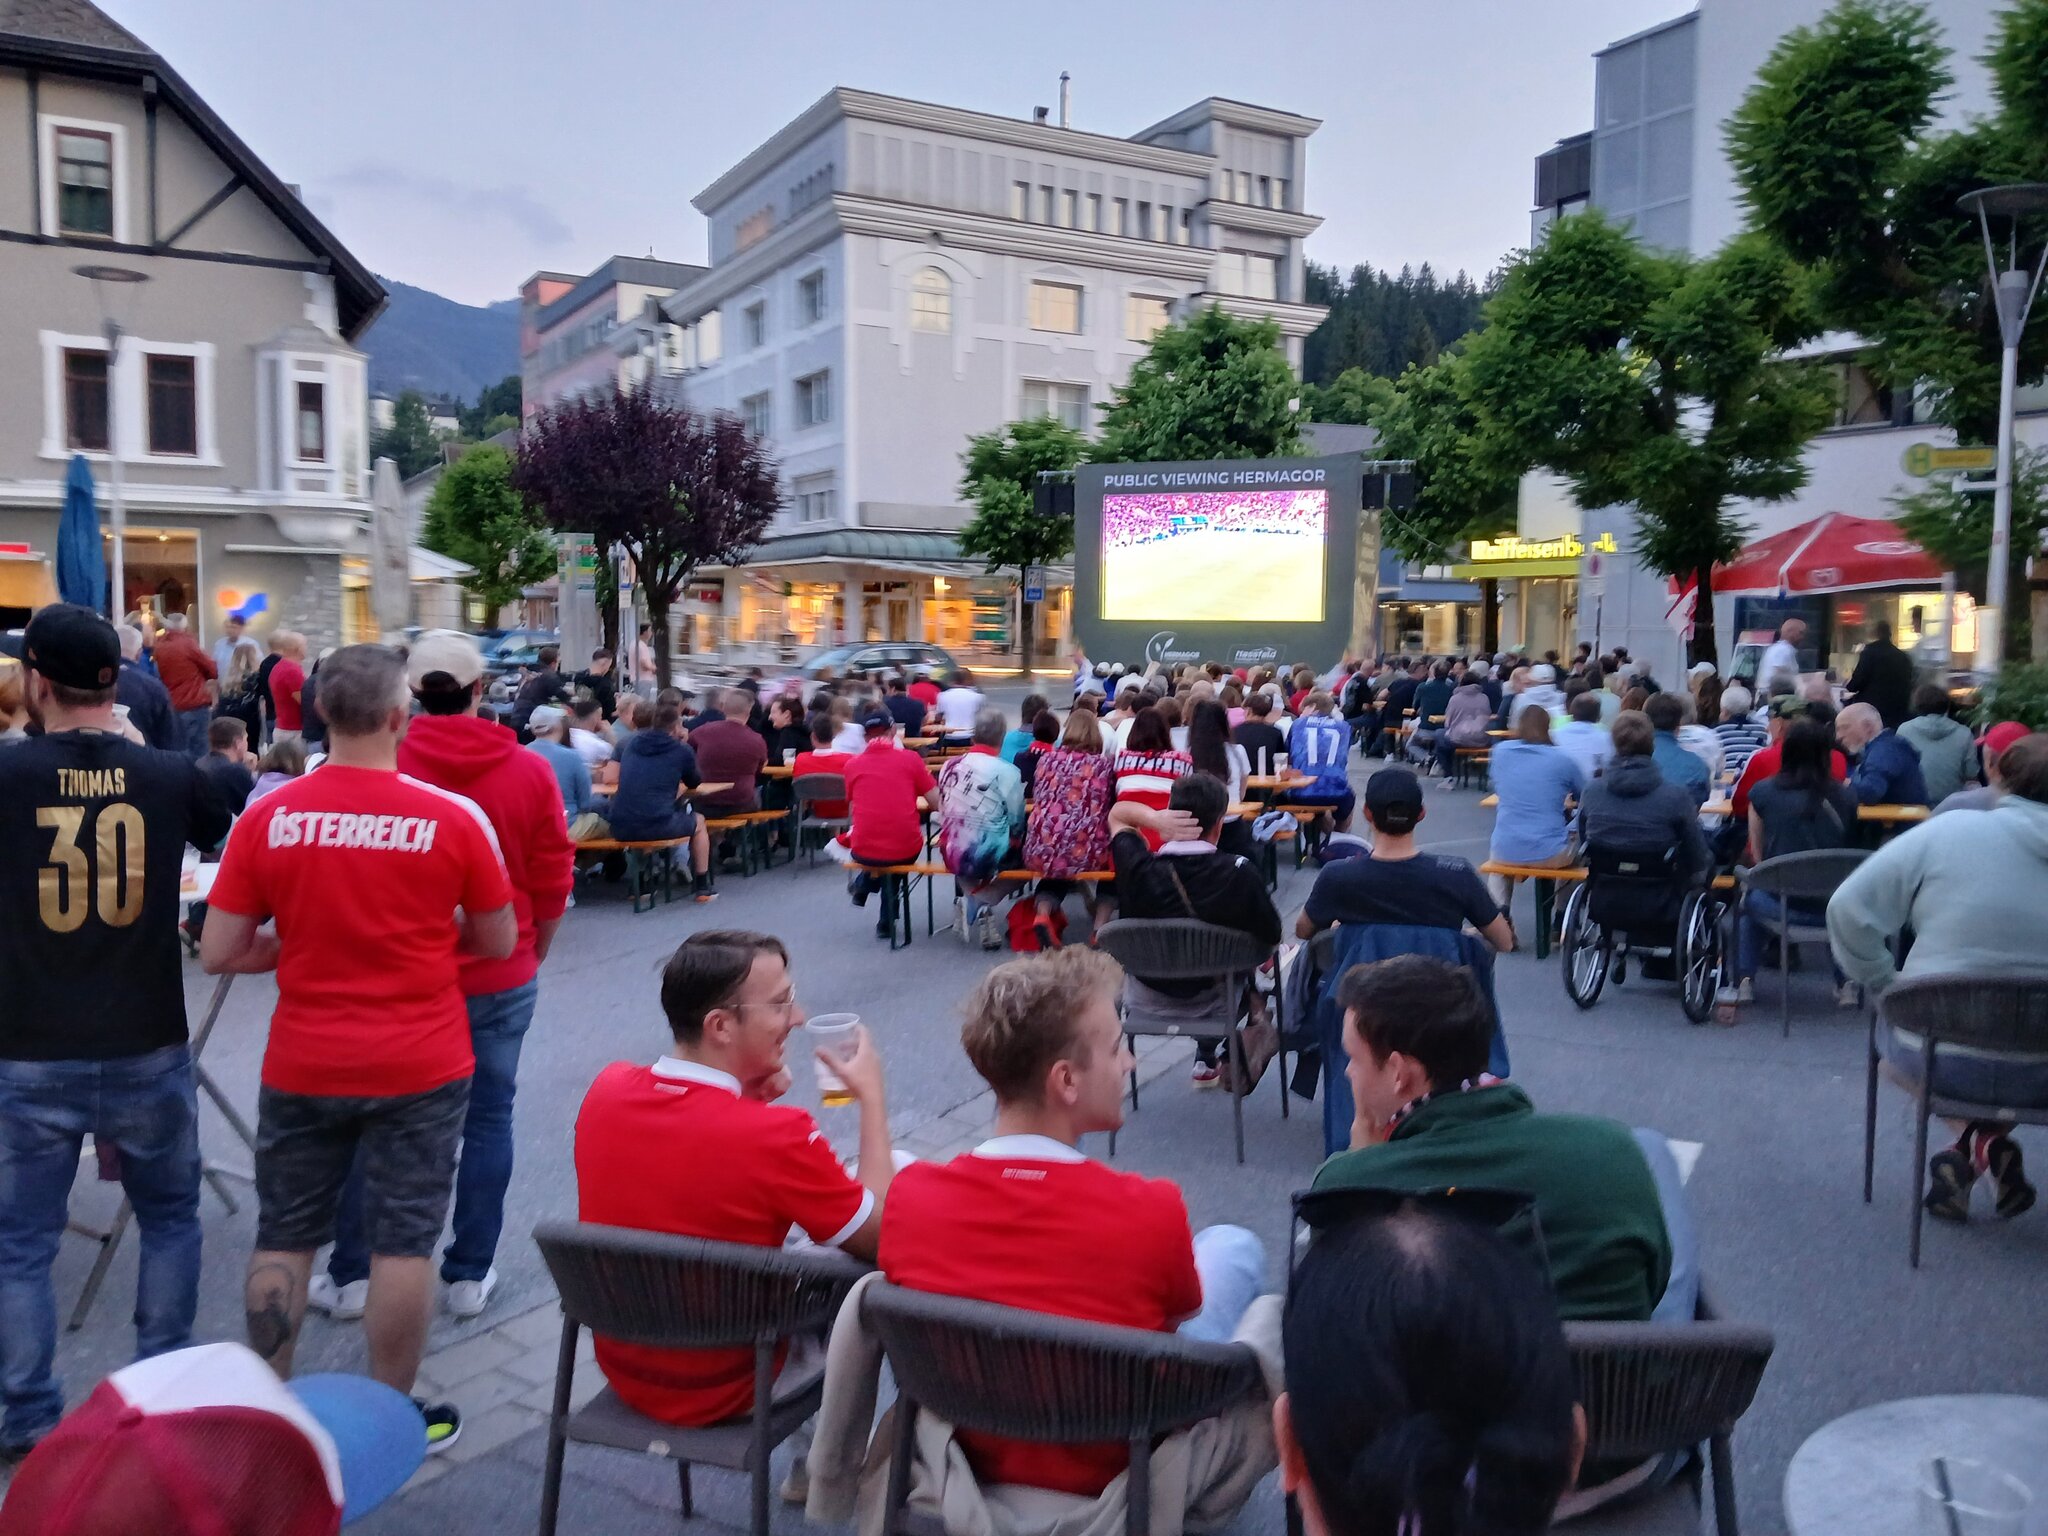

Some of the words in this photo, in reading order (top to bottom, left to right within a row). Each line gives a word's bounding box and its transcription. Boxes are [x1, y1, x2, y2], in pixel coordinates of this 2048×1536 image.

[1103, 474, 1158, 488] PUBLIC
[1161, 472, 1229, 486] VIEWING
[1233, 469, 1326, 484] HERMAGOR
[1304, 727, 1341, 767] 17
[57, 768, 126, 798] THOMAS
[36, 802, 146, 933] 30
